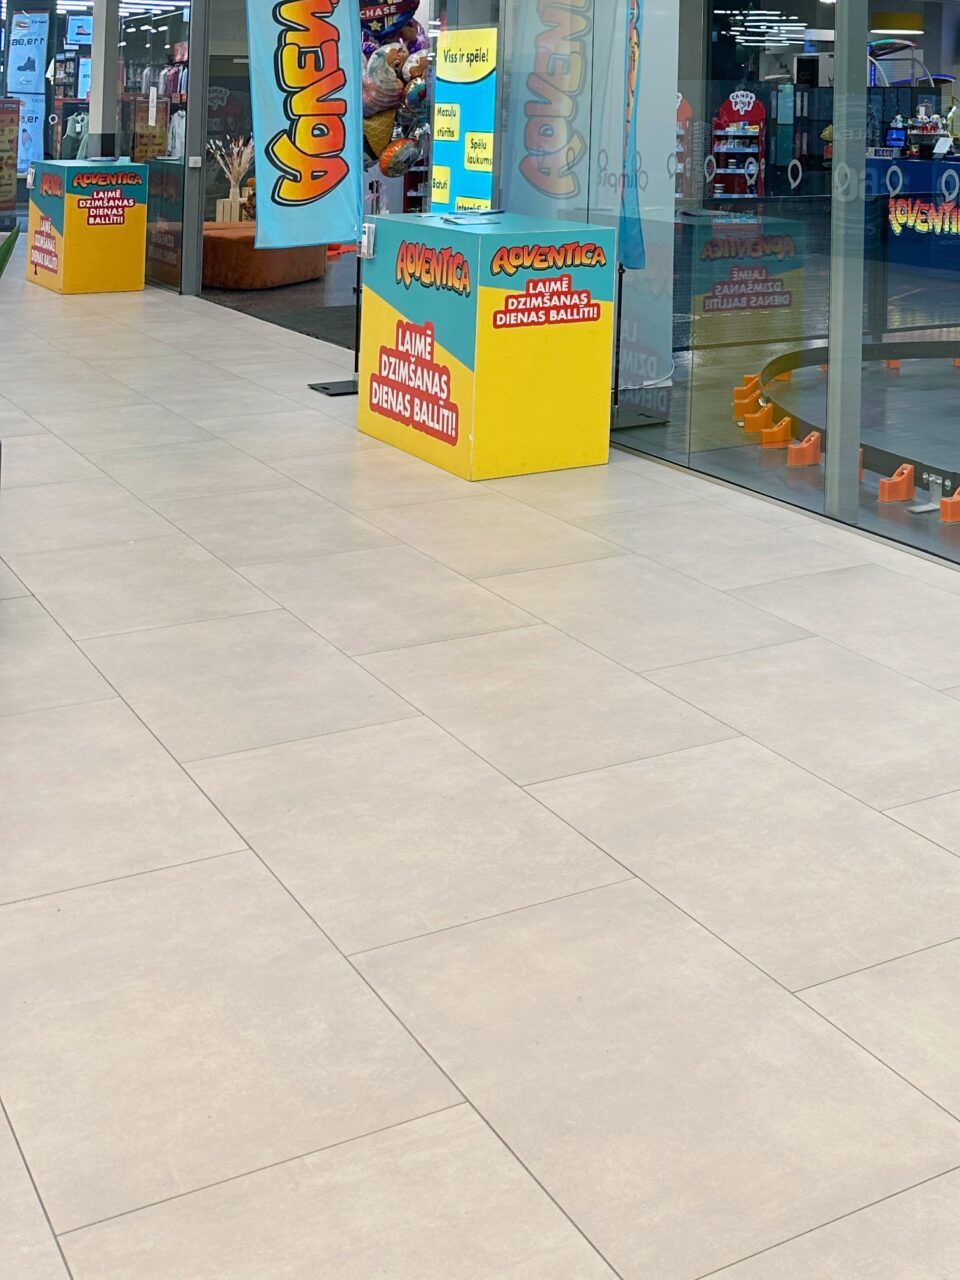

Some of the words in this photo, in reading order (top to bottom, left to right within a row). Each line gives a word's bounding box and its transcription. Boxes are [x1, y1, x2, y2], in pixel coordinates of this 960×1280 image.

[360, 5, 397, 18] CHASE
[443, 49, 458, 63] Viss
[458, 48, 465, 62] ir
[466, 48, 489, 67] spēle!
[72, 172, 143, 189] ADVENTICA
[79, 198, 134, 208] DZIMŠANAS
[93, 190, 121, 199] LAIMĒ
[89, 208, 124, 216] DIENAS
[490, 241, 607, 277] ADVENTICA
[395, 240, 471, 297] ADVENTICA
[529, 277, 569, 294] LAIMĒ
[508, 293, 588, 310] DZIMŠANAS
[496, 310, 546, 325] DIENAS
[549, 305, 598, 321] BALLĪTI!
[398, 328, 432, 361] LAIMĒ
[381, 354, 448, 400] DZIMŠANAS
[372, 381, 411, 418] DIENAS
[413, 397, 456, 438] BALLĪTI!
